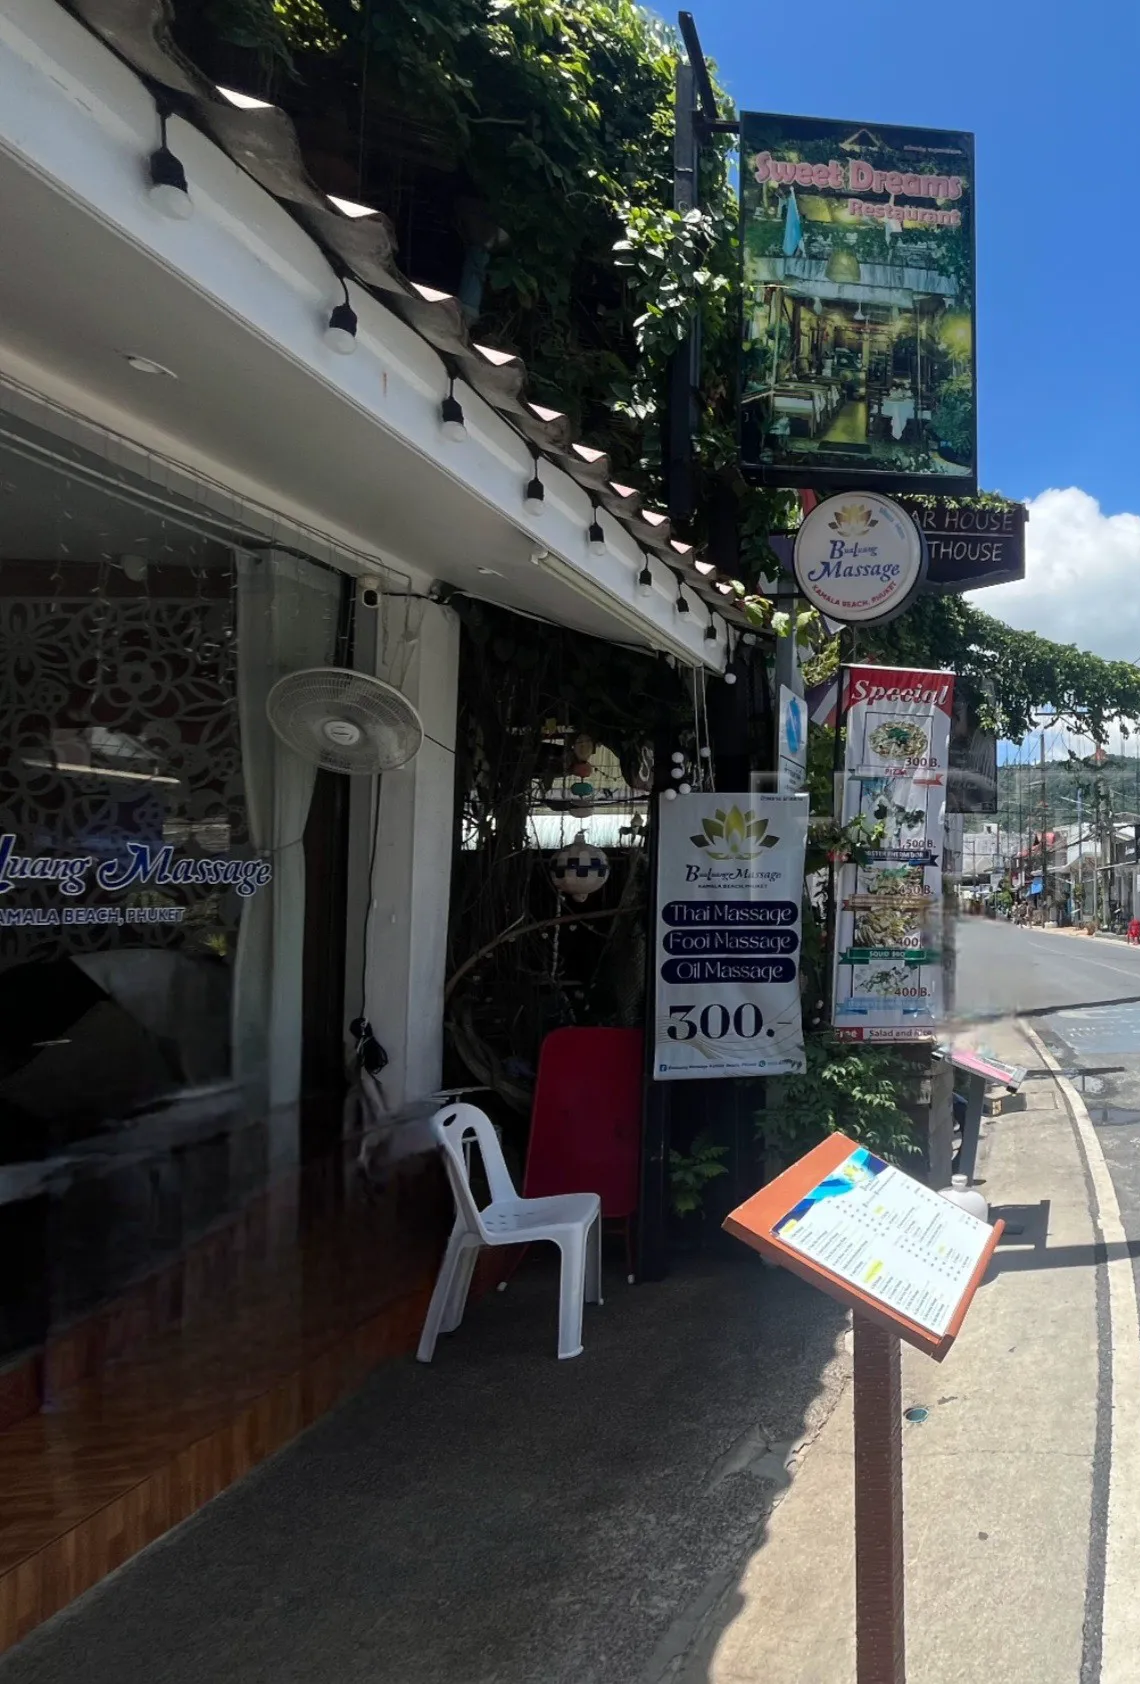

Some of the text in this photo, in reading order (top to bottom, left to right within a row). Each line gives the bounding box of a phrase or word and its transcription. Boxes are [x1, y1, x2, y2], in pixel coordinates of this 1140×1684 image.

[755, 151, 963, 200] Sweet Dreams
[849, 199, 962, 227] Restaurant
[945, 511, 1014, 532] HOUSE
[808, 561, 900, 583] Massage
[811, 583, 841, 606] KAMALA
[870, 581, 897, 604] PHUKET
[851, 679, 949, 706] Special
[905, 757, 927, 767] 300
[97, 842, 273, 897] Massage
[729, 868, 782, 882] Massage
[62, 907, 124, 926] BEACH,
[126, 907, 186, 923] PHUKET
[670, 904, 792, 926] Thai Massage
[669, 932, 791, 954] Foot Massage
[676, 961, 783, 983] Oil Massage
[894, 987, 917, 997] 400
[869, 1029, 894, 1037] Salad
[895, 1029, 913, 1037] and
